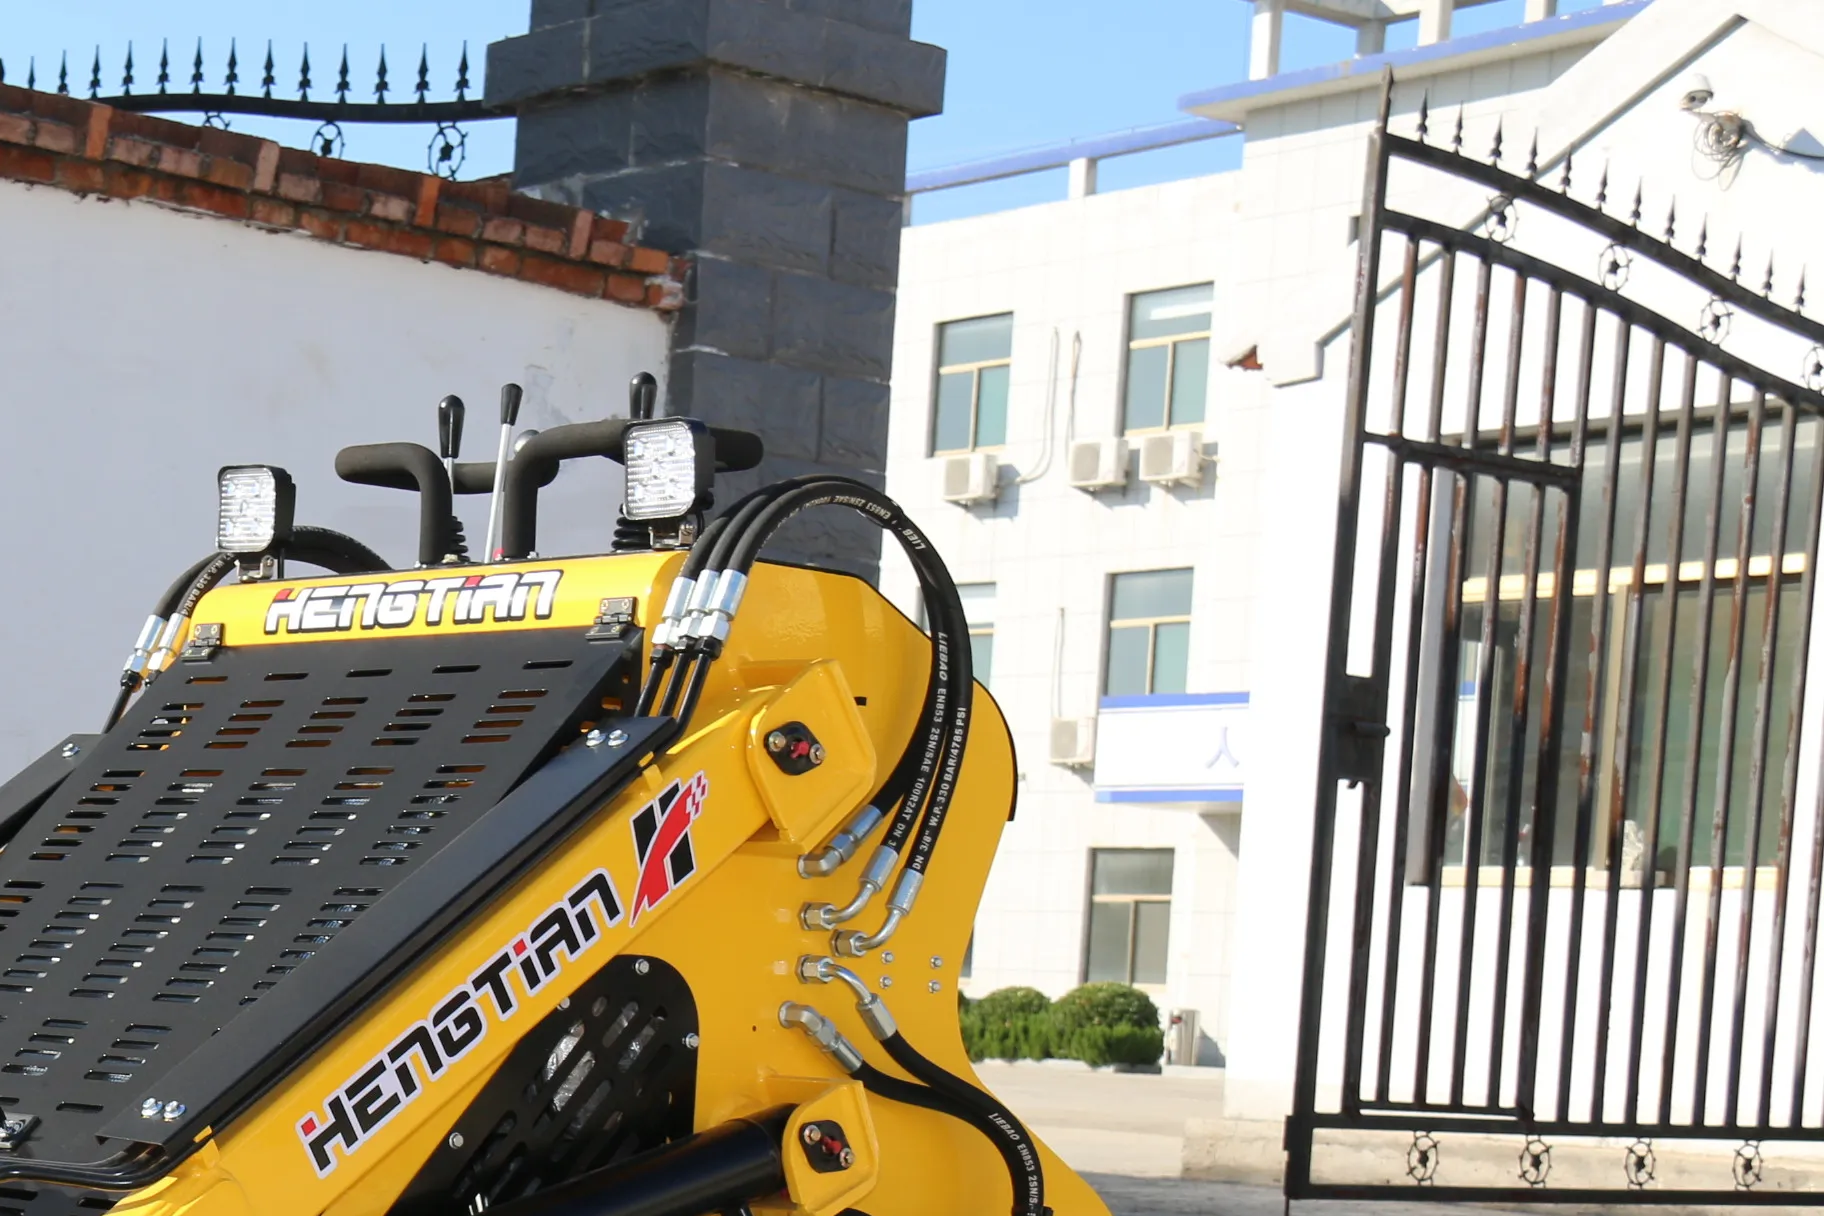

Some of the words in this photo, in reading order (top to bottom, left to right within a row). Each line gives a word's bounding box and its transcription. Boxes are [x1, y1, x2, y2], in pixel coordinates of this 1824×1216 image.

[891, 519, 926, 551] LIEB
[264, 569, 564, 634] HENGTIAN
[938, 631, 948, 681] LIEBAO
[933, 688, 947, 723] EN853
[955, 707, 967, 726] PSI
[920, 727, 941, 773] 2SN/SAE
[943, 728, 964, 781] BAR/4785
[902, 777, 926, 821] 100R2AT
[937, 783, 950, 804] 330
[893, 822, 906, 838] DN
[912, 855, 925, 870] DN
[299, 870, 622, 1175] HENGTIAN
[988, 1112, 1021, 1140] LIEBAO
[1017, 1143, 1035, 1171] EN853
